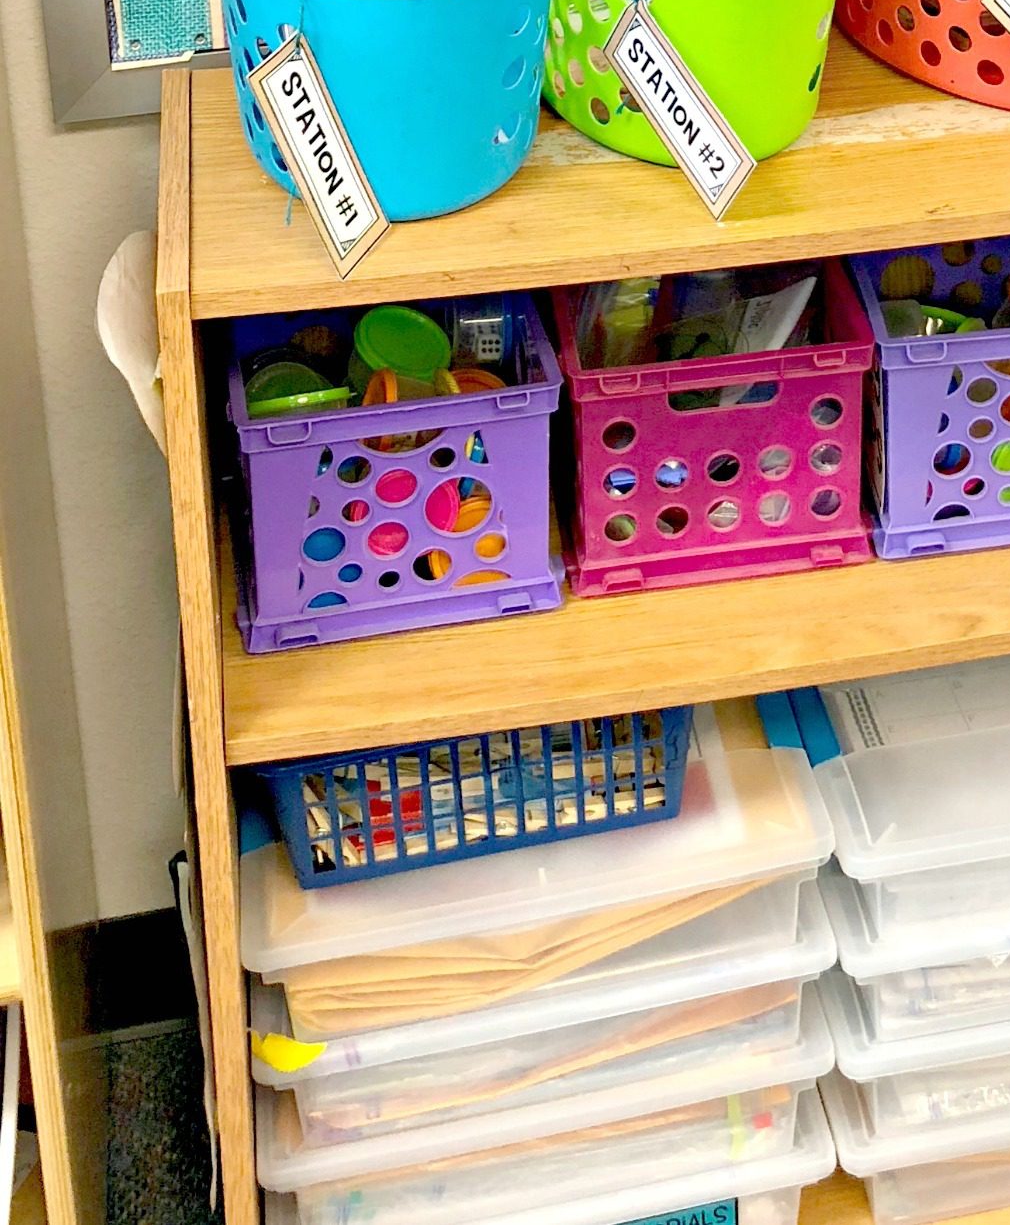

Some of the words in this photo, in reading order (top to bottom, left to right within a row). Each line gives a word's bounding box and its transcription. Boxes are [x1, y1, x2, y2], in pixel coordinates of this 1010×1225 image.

[282, 71, 344, 196] STATION
[335, 194, 358, 227] #1
[628, 38, 700, 145] STATION
[698, 142, 726, 180] #2
